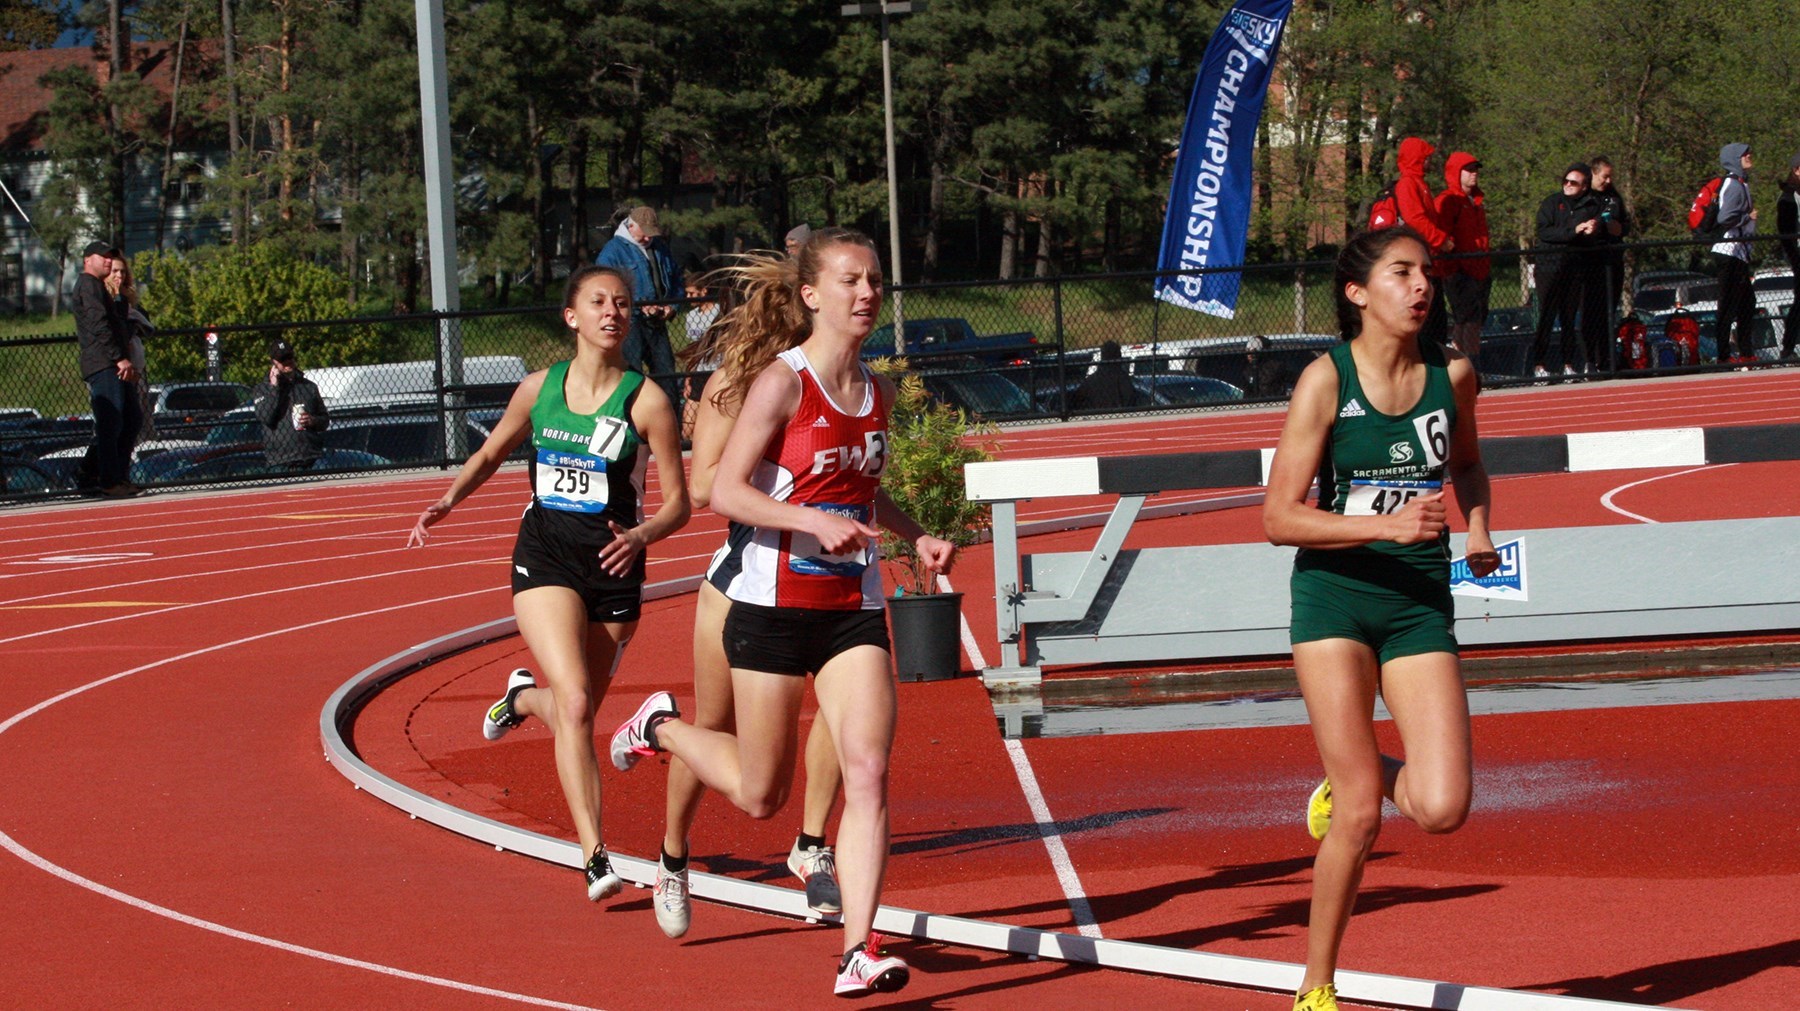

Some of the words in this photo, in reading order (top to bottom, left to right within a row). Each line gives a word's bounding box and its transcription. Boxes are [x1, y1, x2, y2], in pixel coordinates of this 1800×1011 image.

[1340, 409, 1366, 418] adidas
[542, 428, 570, 441] NORTH
[571, 433, 592, 445] DAK
[597, 418, 624, 454] 7
[1426, 415, 1447, 462] 6
[810, 445, 869, 475] EW
[869, 433, 885, 476] 3
[554, 468, 590, 494] 259
[1353, 465, 1417, 478] SACRAMENTO
[1474, 576, 1518, 584] CONFERENCE
